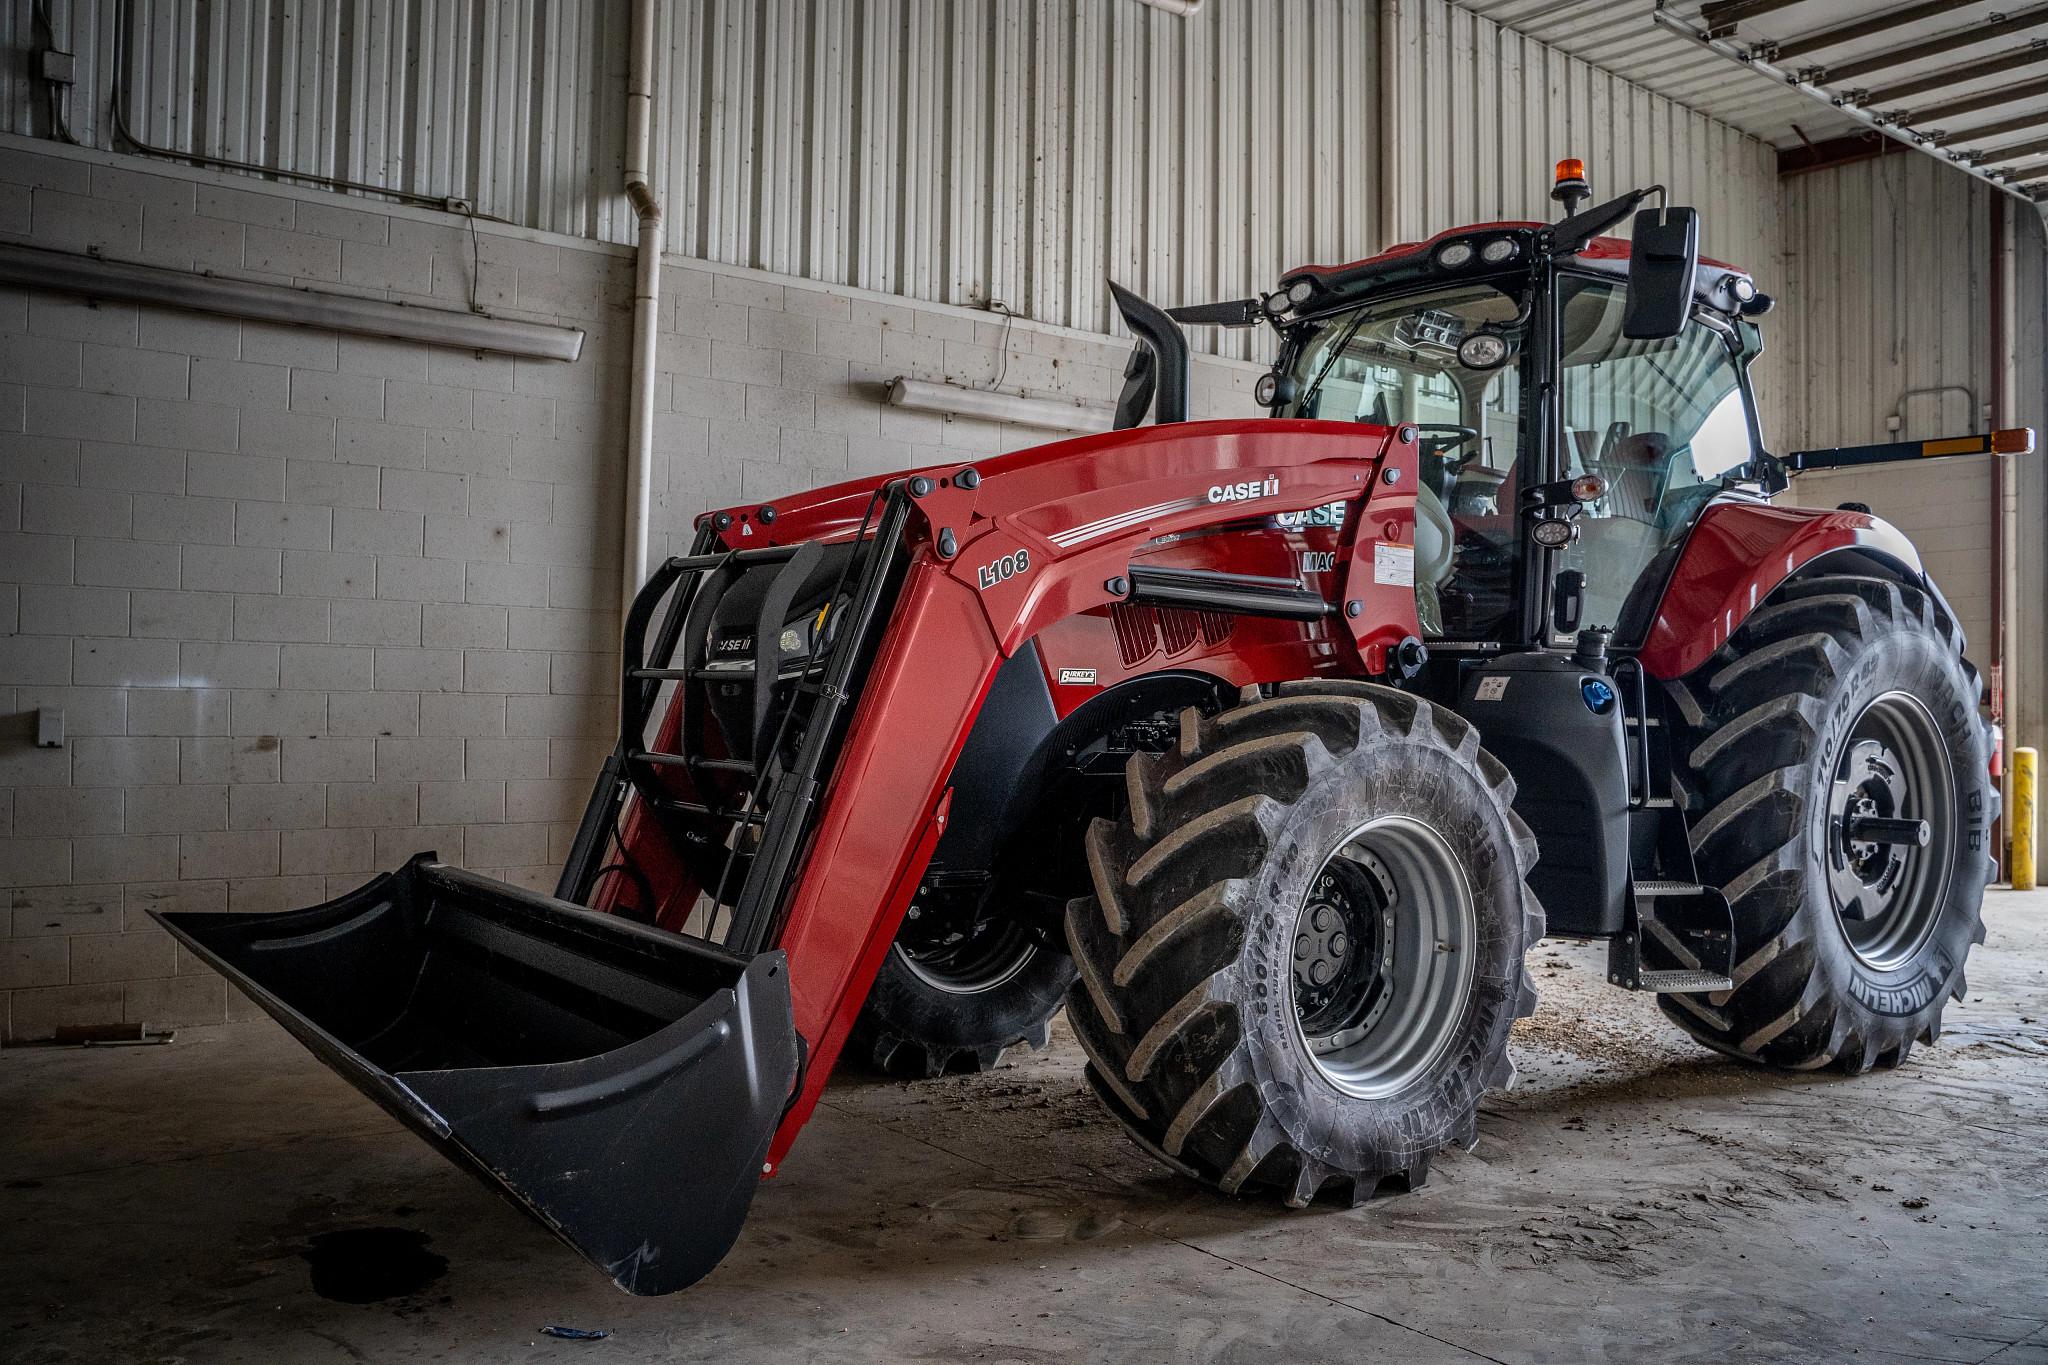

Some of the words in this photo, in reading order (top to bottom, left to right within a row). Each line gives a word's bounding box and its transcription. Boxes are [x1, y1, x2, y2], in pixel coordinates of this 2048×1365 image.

[1207, 481, 1261, 503] CASE
[1275, 499, 1347, 528] CASE
[978, 548, 1030, 590] L108
[1967, 788, 1983, 852] BIB
[1849, 975, 1934, 1014] MICHELIN
